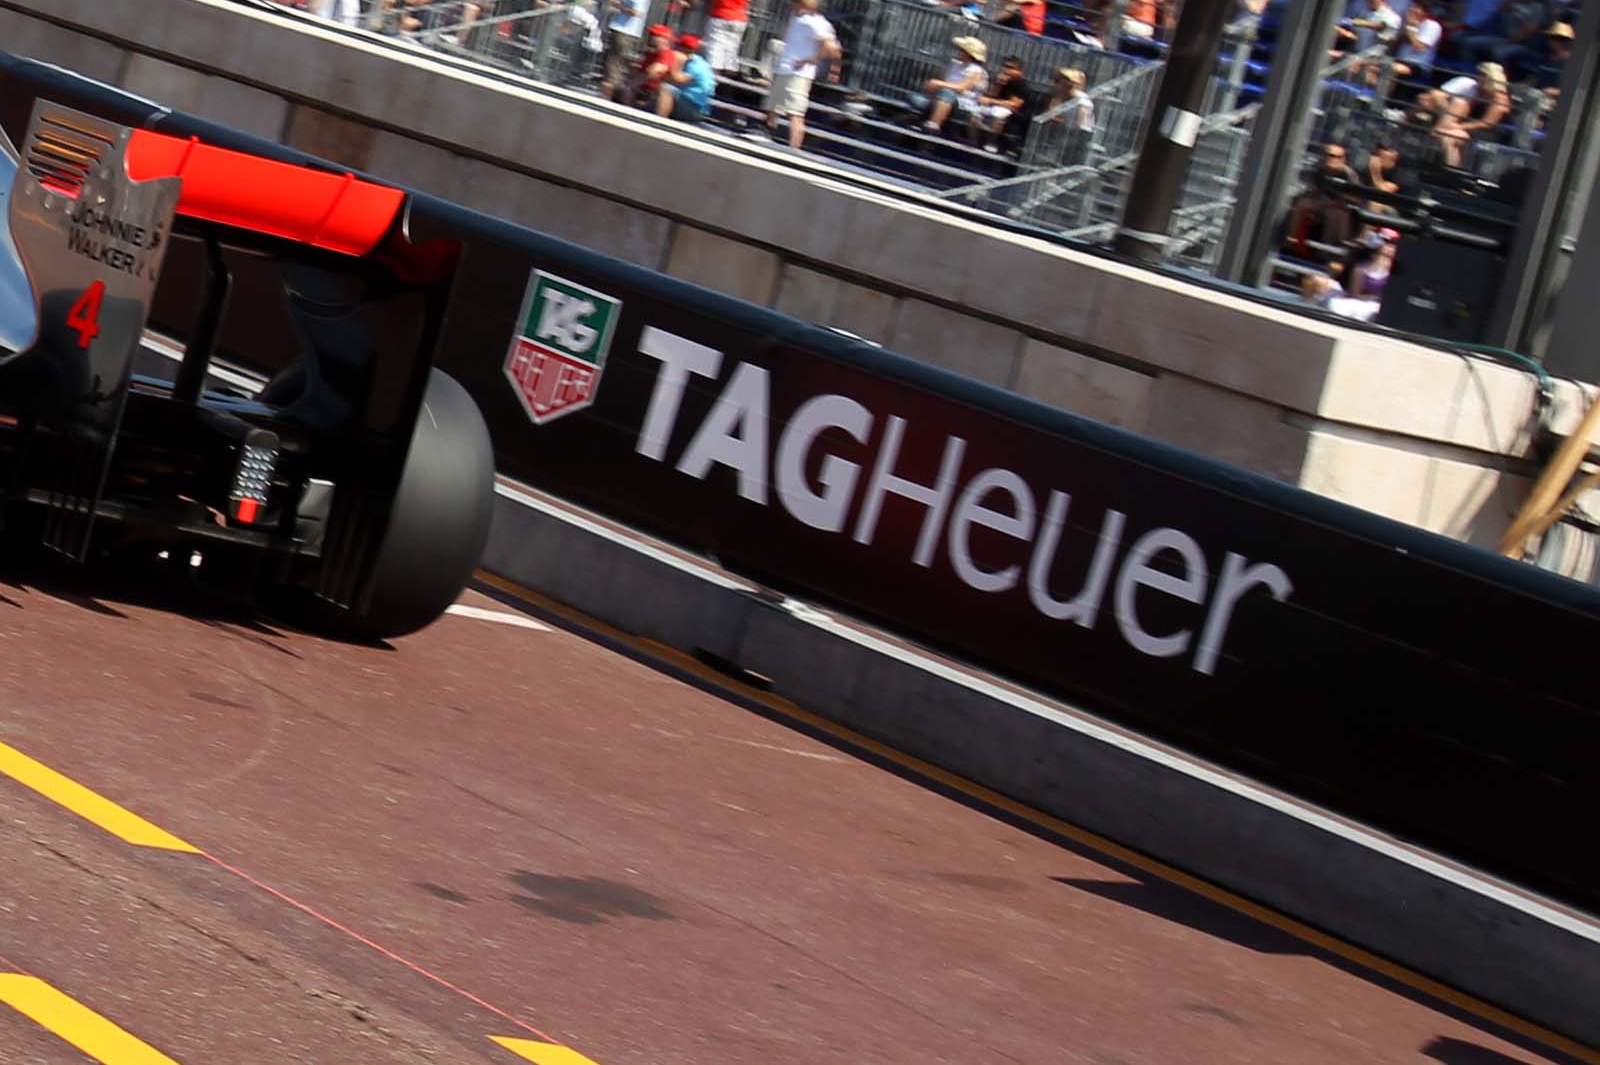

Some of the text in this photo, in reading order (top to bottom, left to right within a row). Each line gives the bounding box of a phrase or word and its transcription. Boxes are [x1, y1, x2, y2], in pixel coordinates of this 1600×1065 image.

[67, 227, 137, 277] WALKER
[71, 201, 147, 248] JOHNNIE
[64, 278, 107, 351] 4
[635, 324, 1293, 676] TAGHeuer
